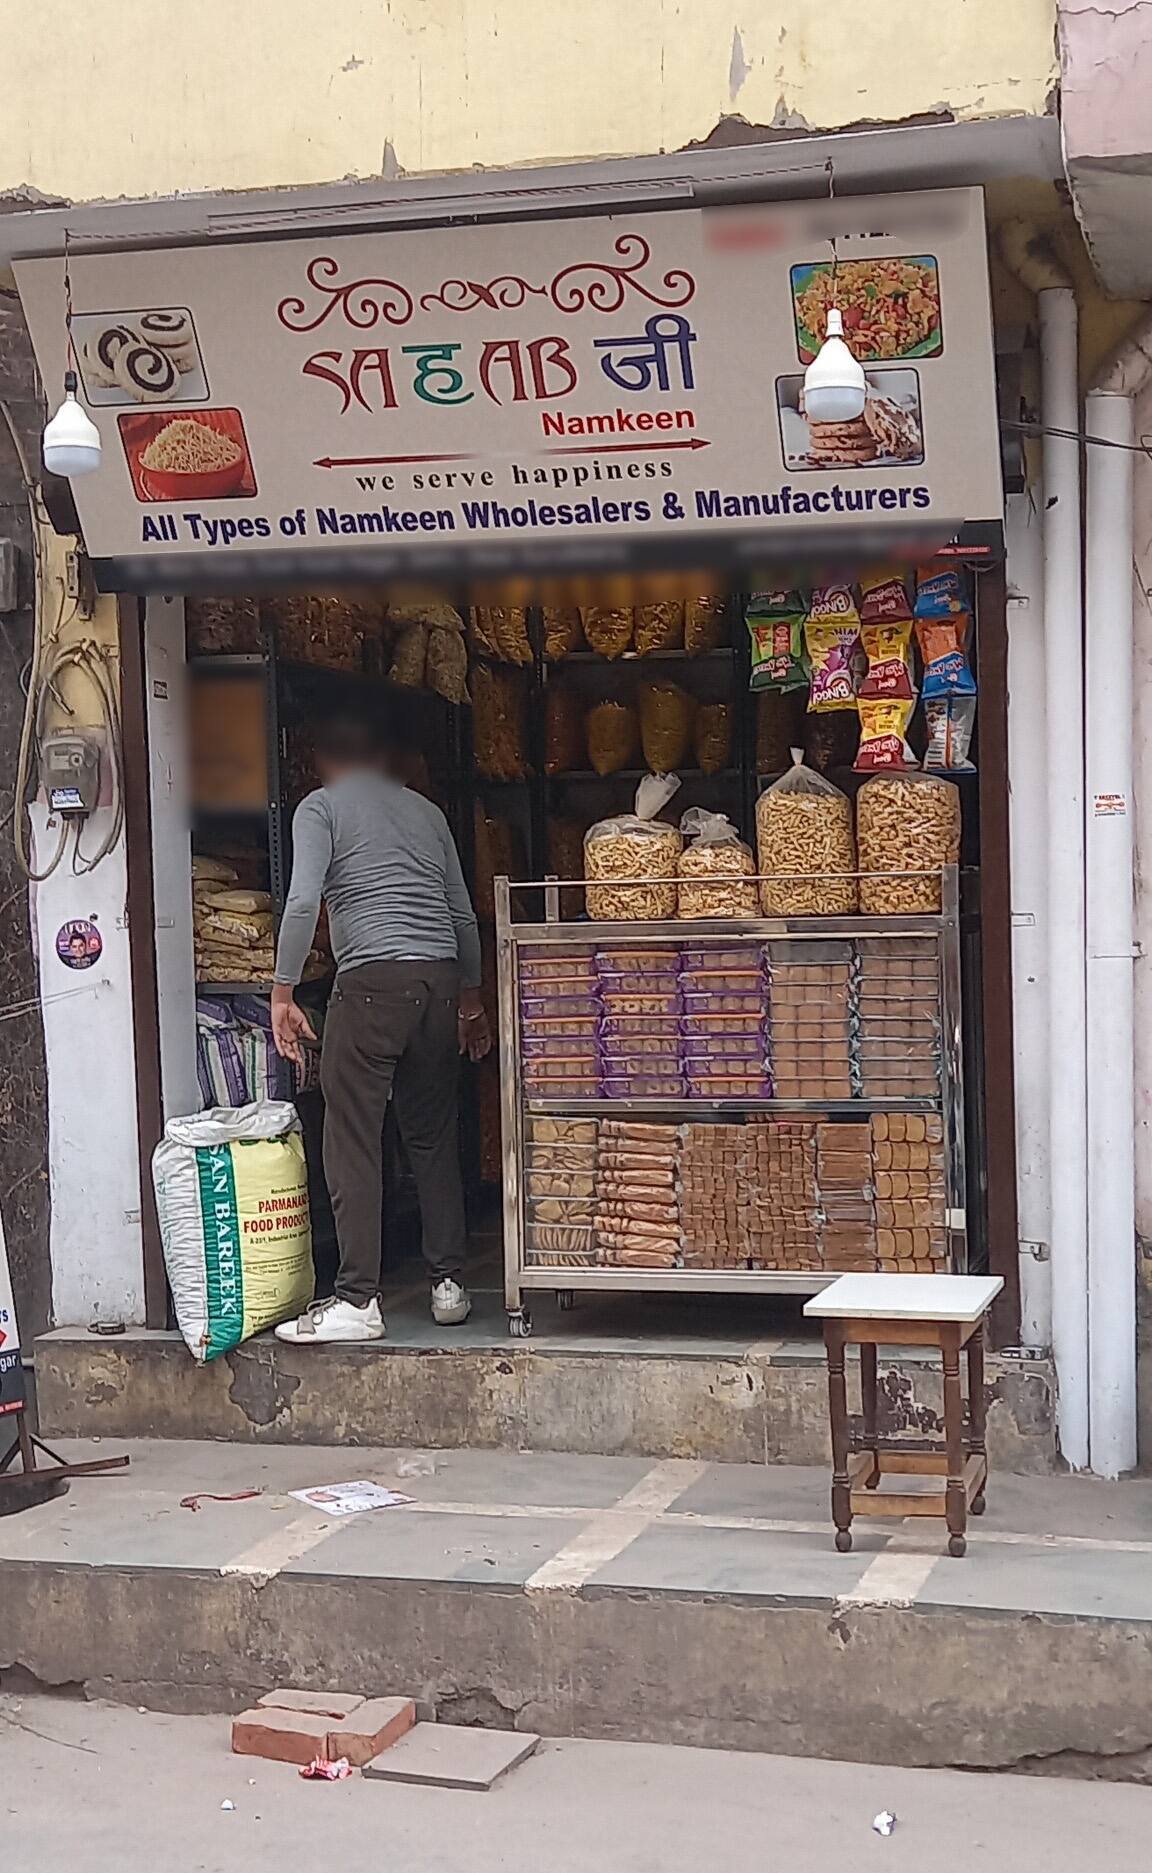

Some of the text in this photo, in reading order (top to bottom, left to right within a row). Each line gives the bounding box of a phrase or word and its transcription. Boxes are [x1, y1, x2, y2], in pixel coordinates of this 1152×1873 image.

[593, 314, 697, 391] जी
[541, 408, 695, 436] Namkeen
[355, 460, 673, 492] we serve happiness
[142, 484, 932, 546] All Types of Namkeen Wholesalers & Manufacturers
[243, 1218, 274, 1234] FOOD
[214, 1200, 237, 1317] BAREEK
